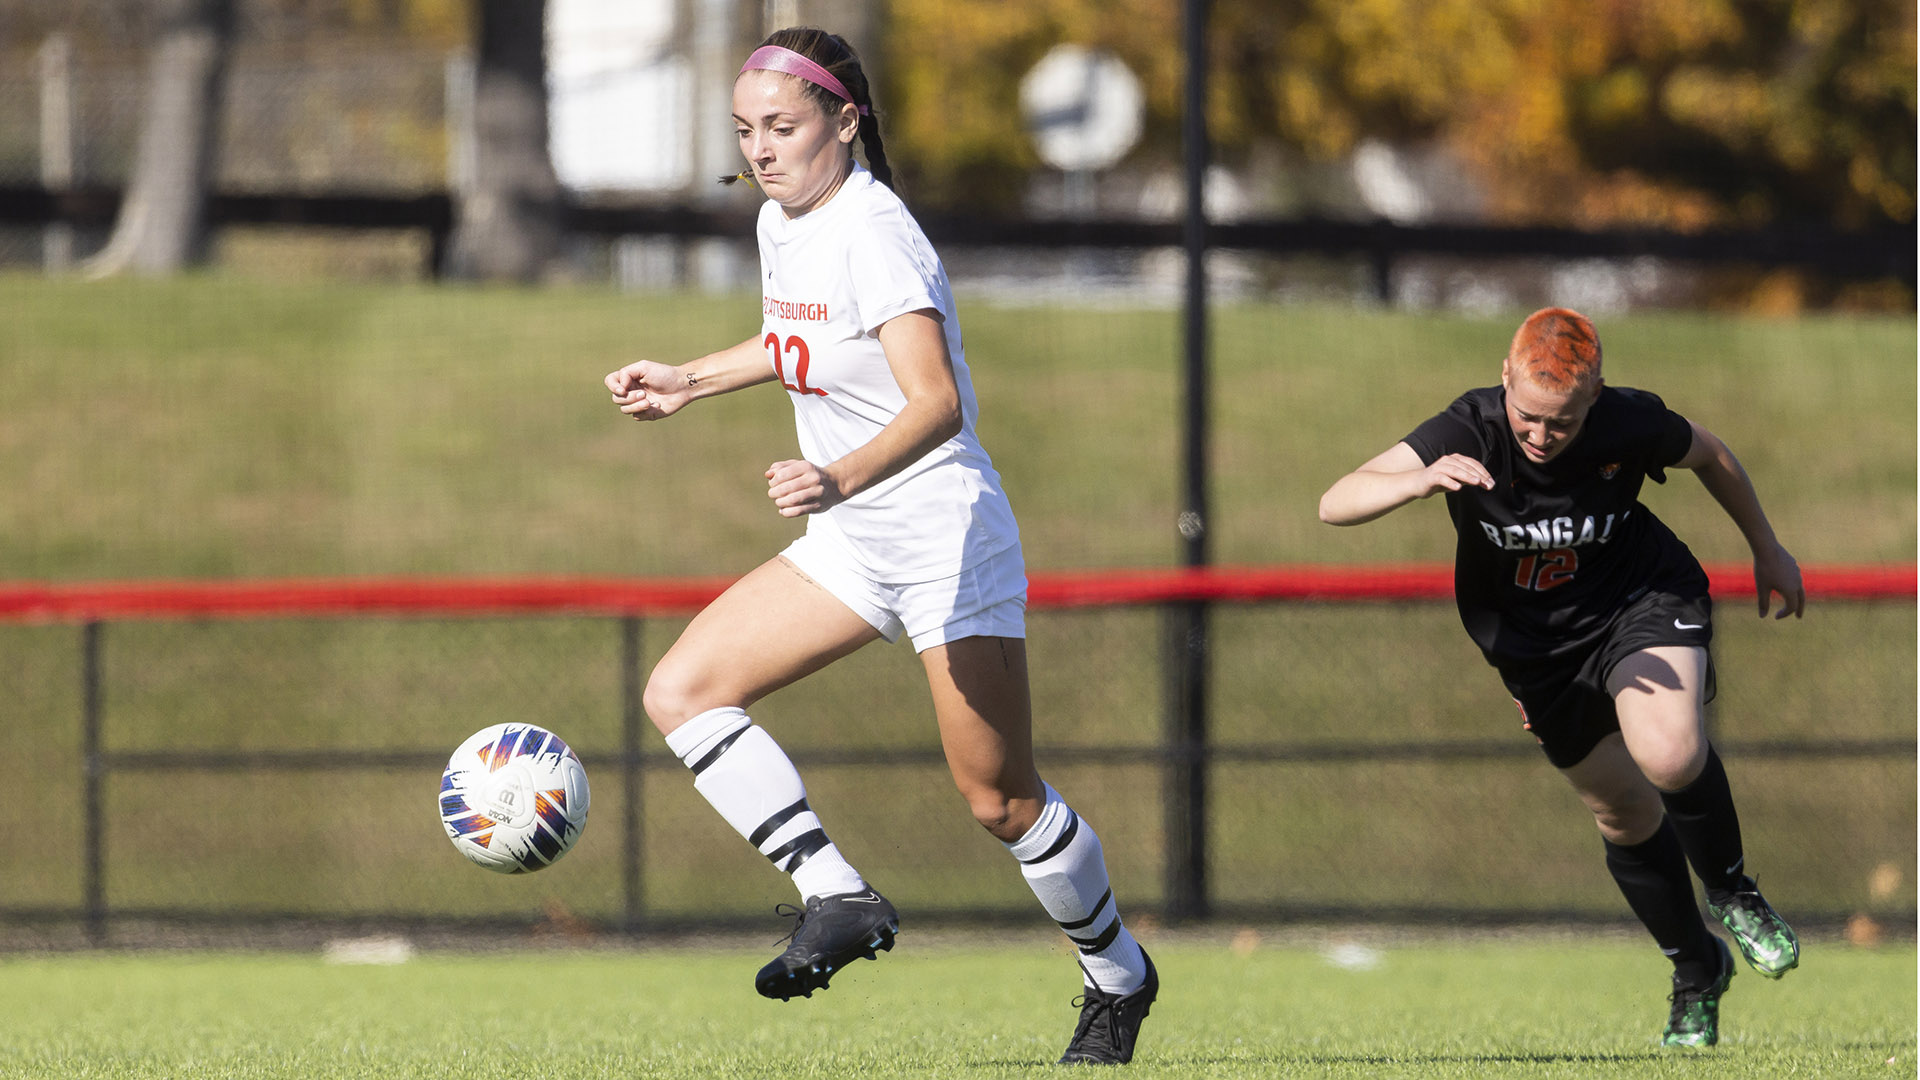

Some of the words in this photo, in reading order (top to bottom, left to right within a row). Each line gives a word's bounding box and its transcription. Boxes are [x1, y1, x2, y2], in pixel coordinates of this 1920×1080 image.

[764, 331, 829, 397] 22
[1479, 510, 1630, 550] BENGAL
[1515, 548, 1578, 592] 12
